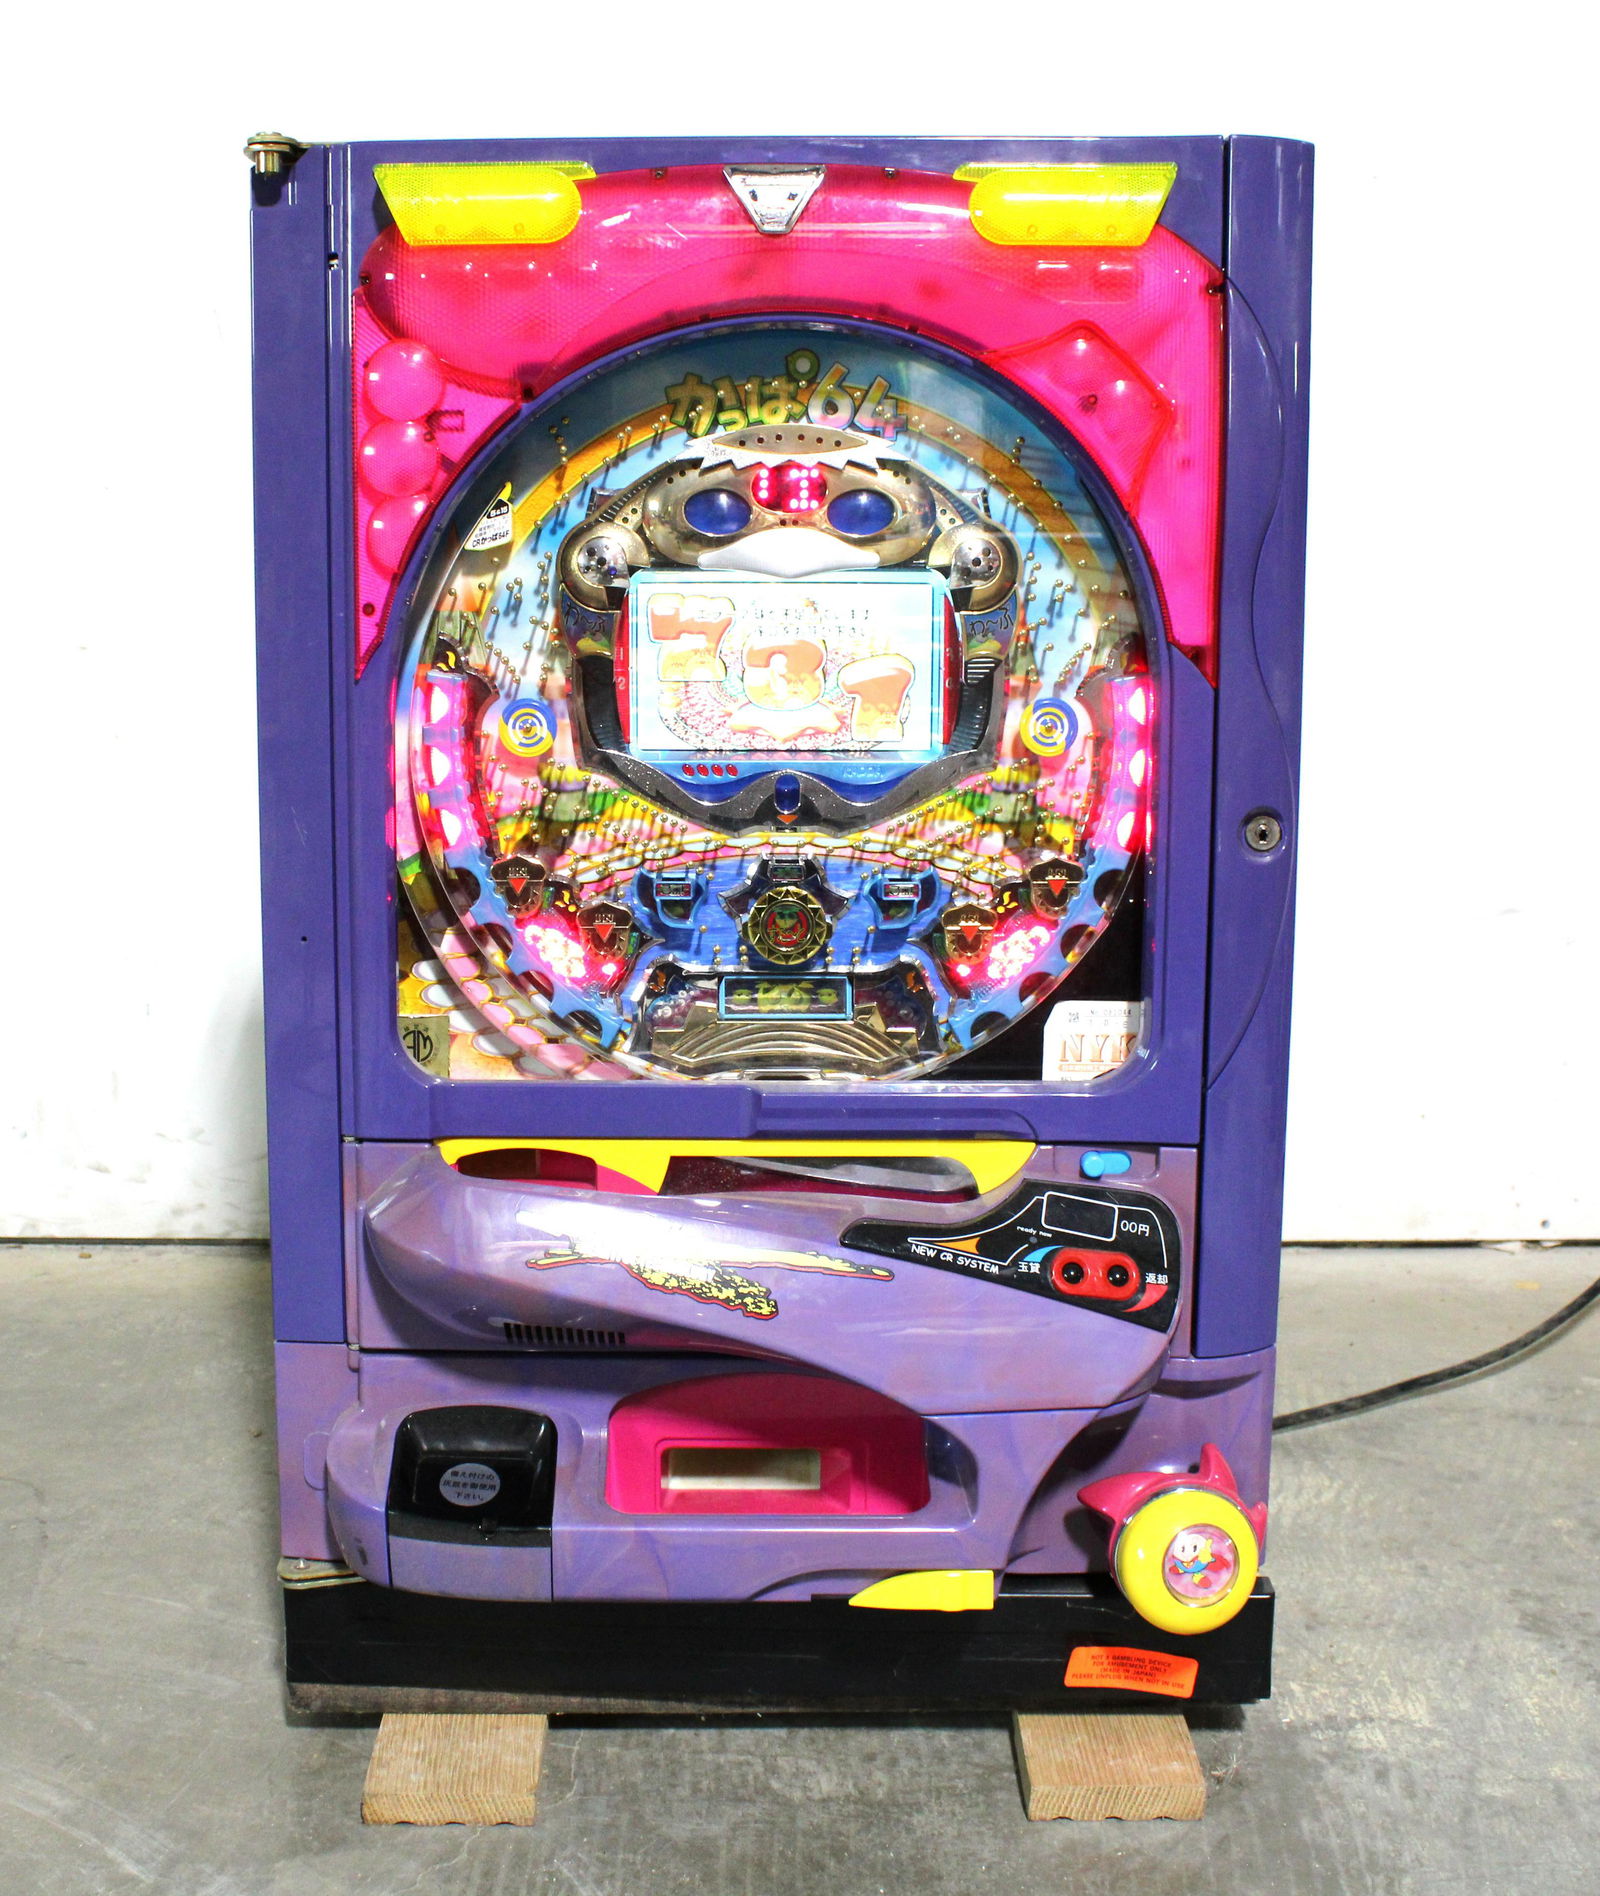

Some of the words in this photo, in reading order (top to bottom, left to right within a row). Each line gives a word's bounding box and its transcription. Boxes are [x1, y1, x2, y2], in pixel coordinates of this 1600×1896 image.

[1016, 1226, 1037, 1236] ready
[1039, 1230, 1053, 1238] now
[1120, 1220, 1150, 1237] 00円
[911, 1243, 938, 1258] NEW
[940, 1251, 954, 1263] CR
[956, 1256, 1000, 1275] SYSTEM
[1145, 1272, 1169, 1285] 返却
[1111, 1654, 1146, 1664] GAMBLING
[1148, 1659, 1172, 1668] DEVICE
[1123, 1674, 1144, 1683] WHEN
